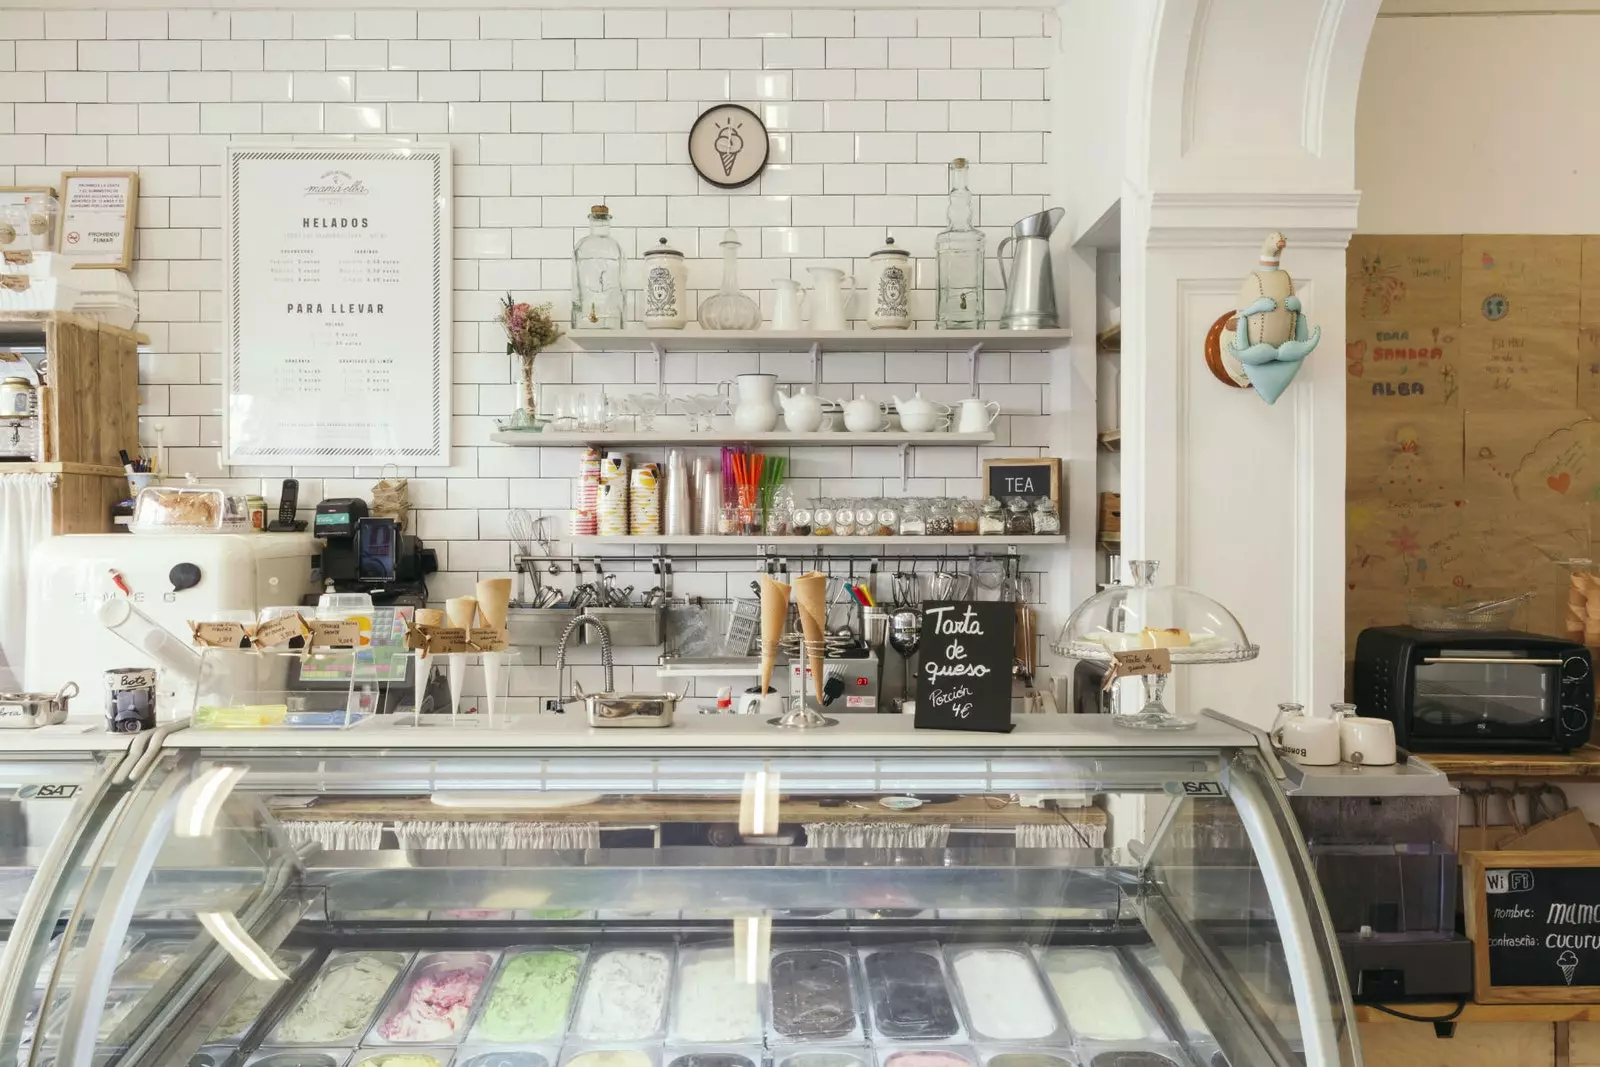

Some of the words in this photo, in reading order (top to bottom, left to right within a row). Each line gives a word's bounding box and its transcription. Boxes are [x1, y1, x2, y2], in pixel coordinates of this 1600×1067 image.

[302, 217, 369, 228] HELADOS
[287, 303, 323, 314] PARA
[331, 303, 385, 314] LLEVAR
[1372, 346, 1443, 362] SANDRA
[1371, 382, 1425, 396] ALBA
[1004, 477, 1034, 493] TEA
[925, 604, 984, 636] Tarta
[946, 638, 967, 660] de
[925, 661, 991, 685] queso
[928, 685, 974, 708] Porción
[952, 702, 974, 719] 4€
[37, 784, 65, 796] ISA
[1182, 781, 1212, 792] ISA
[1494, 904, 1535, 919] nombre:
